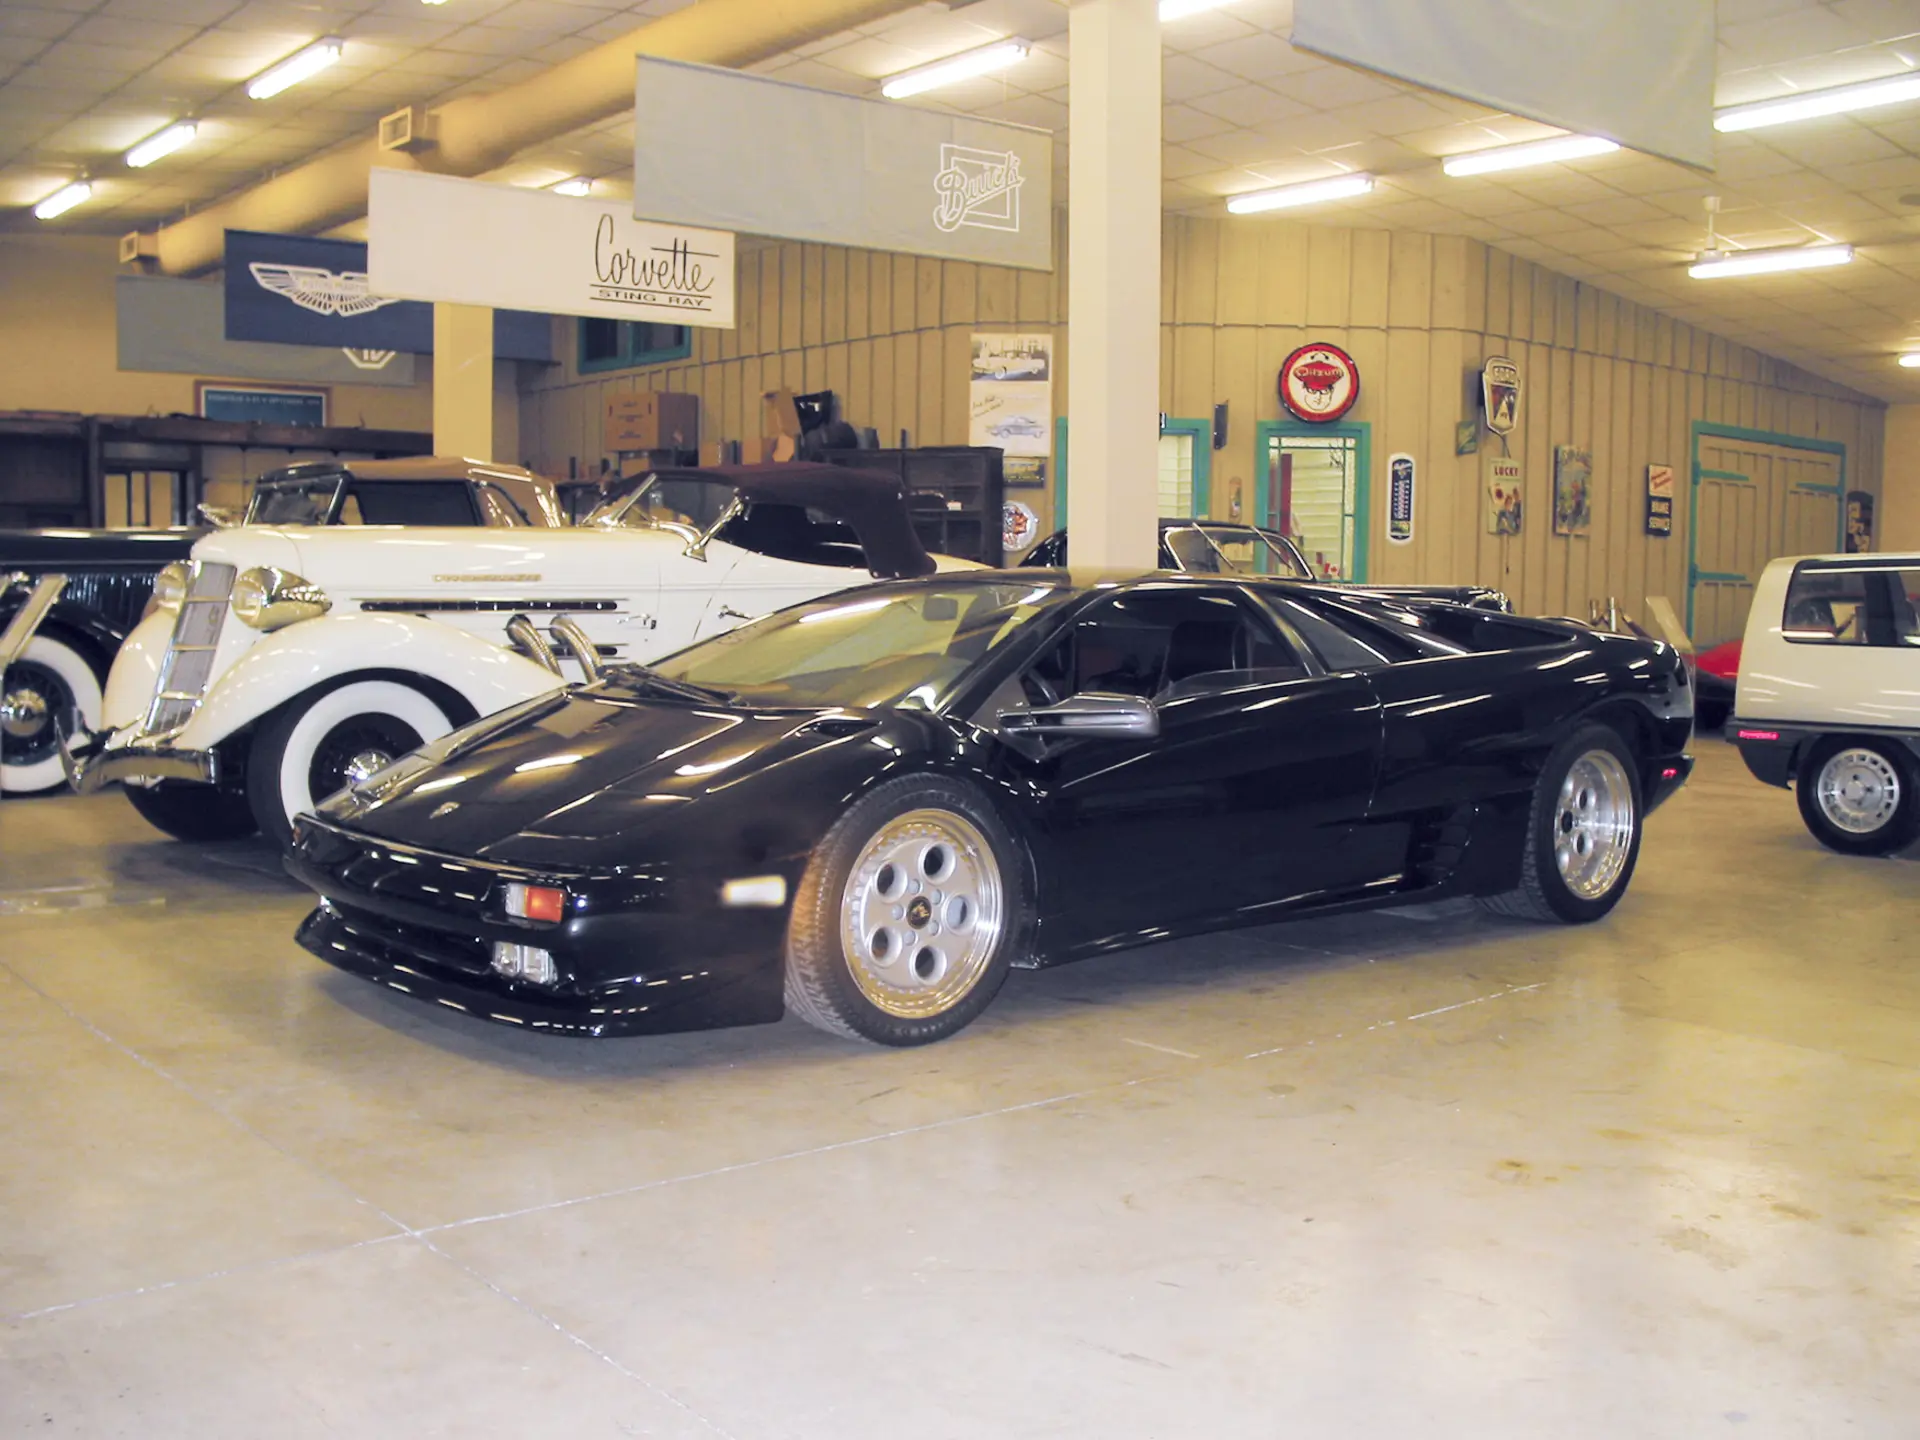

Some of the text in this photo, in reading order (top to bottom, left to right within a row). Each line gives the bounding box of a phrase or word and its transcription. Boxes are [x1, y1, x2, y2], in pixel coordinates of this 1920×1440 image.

[933, 150, 1025, 232] Buick
[595, 213, 719, 292] Corvette
[599, 289, 704, 307] STING RAY
[1495, 466, 1518, 476] LUCKY
